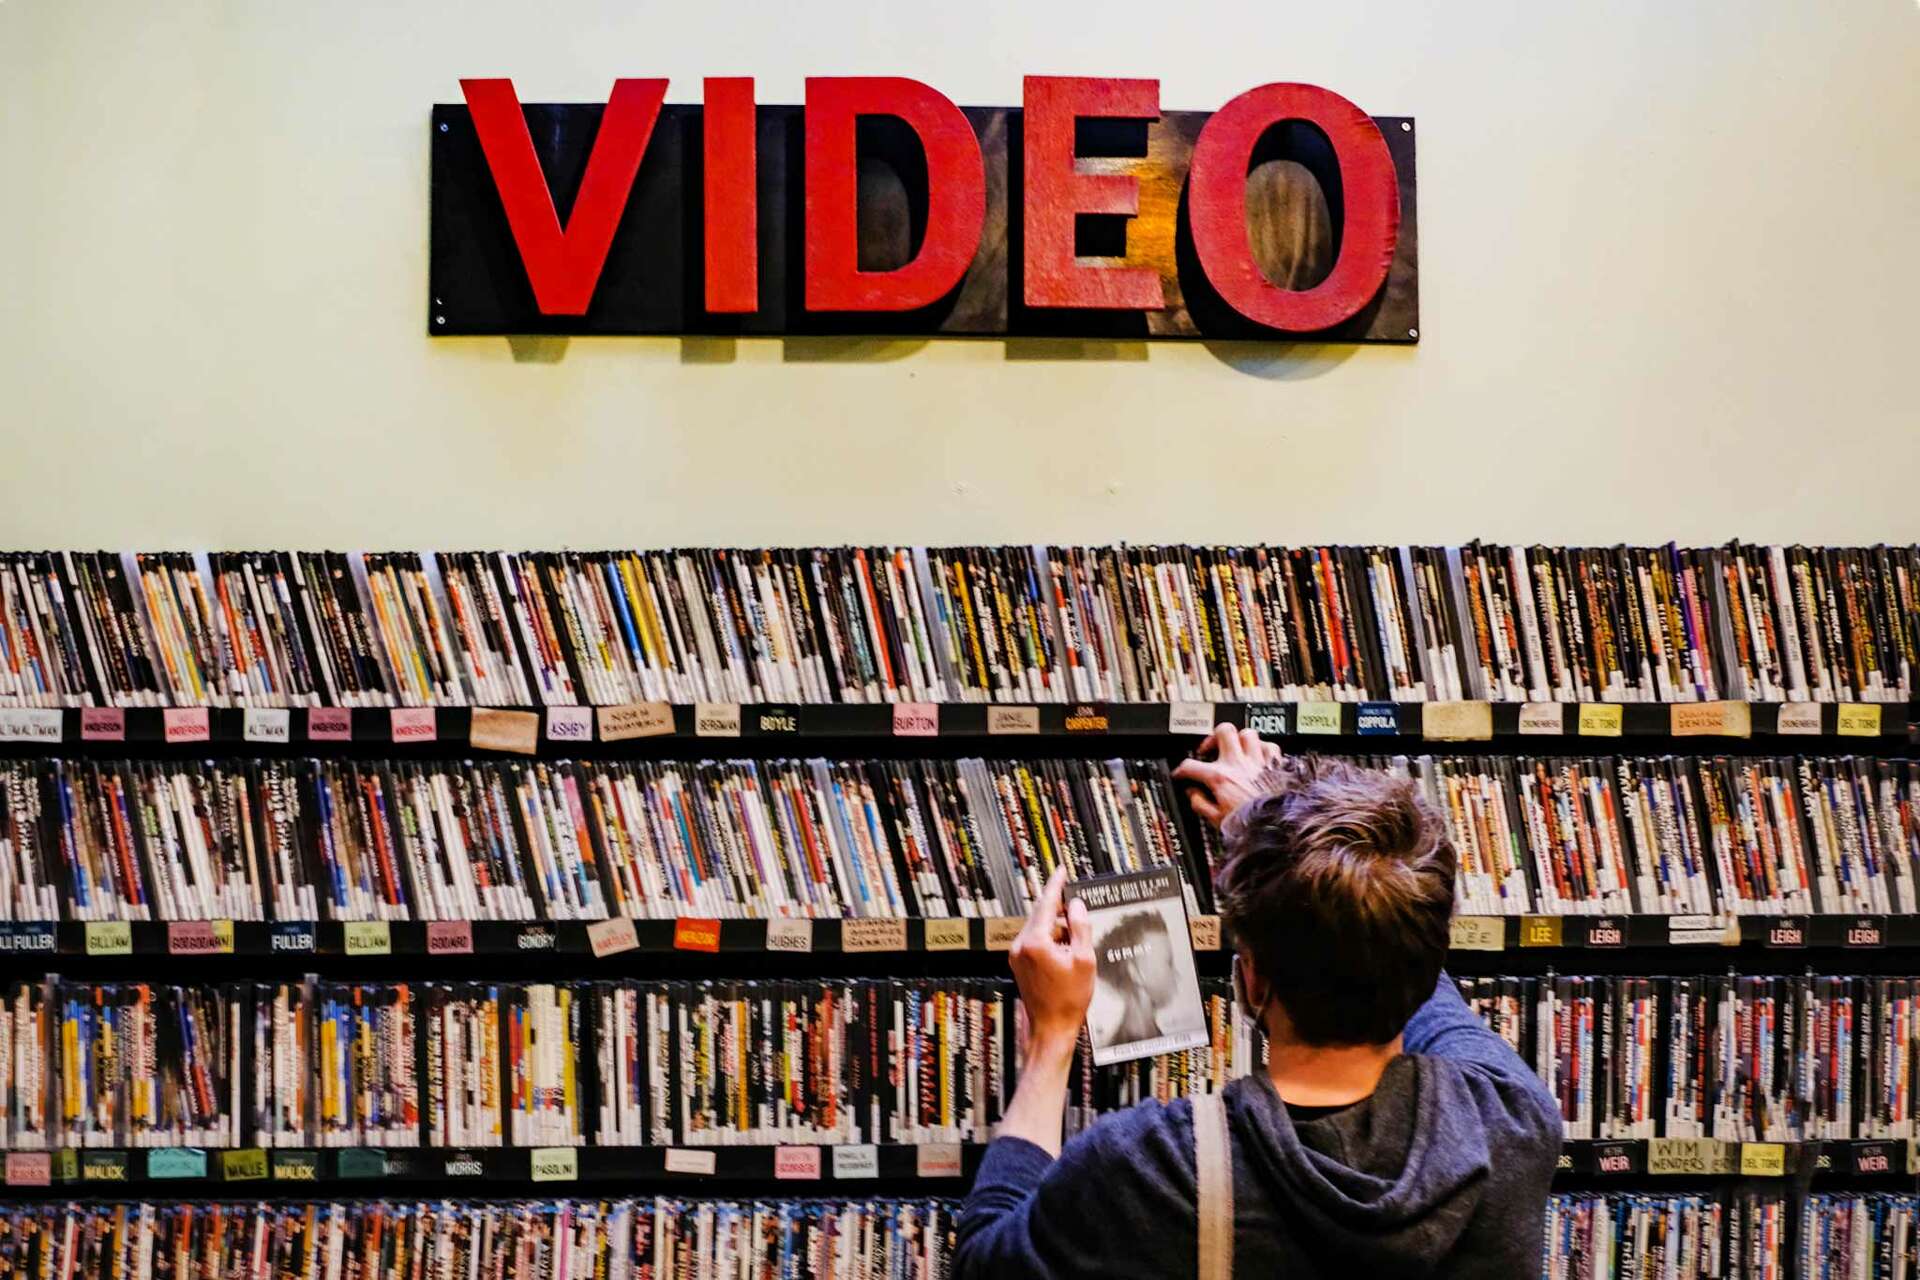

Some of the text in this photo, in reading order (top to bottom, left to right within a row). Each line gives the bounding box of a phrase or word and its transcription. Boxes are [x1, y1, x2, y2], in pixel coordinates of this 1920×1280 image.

[459, 76, 1400, 333] VIDEO
[85, 723, 122, 733] ANDERSON
[312, 723, 348, 733] ANDERSON
[700, 719, 738, 731] BERGMAN
[760, 715, 797, 733] BOYLE
[895, 716, 935, 731] BURTON
[1250, 716, 1287, 734] COEN
[1301, 715, 1338, 728] COPPOLA
[1358, 716, 1397, 729] COPPOLA
[1582, 719, 1619, 729] DEL TORO
[1858, 719, 1877, 729] TORO
[169, 725, 207, 736] ANDERSON
[249, 724, 285, 737] ALTMAN
[396, 725, 433, 737] ANDERSON
[272, 934, 313, 951] FULLER
[517, 934, 556, 949] GONDRY
[769, 934, 807, 949] HUGHES
[928, 935, 966, 945] JACKSON
[1454, 930, 1492, 945] LEE
[1529, 928, 1553, 944] LEE
[1589, 928, 1621, 944] LEIGH
[1770, 929, 1802, 944] LEIGH
[1848, 929, 1880, 944] LEIGH
[1106, 943, 1152, 963] GUMMO
[1655, 1141, 1699, 1157] WIM
[446, 1162, 483, 1176] MORRIS
[1599, 1156, 1631, 1172] WEIR
[1651, 1158, 1705, 1173] WENDERS
[1744, 1159, 1780, 1169] DEL TORO
[1857, 1155, 1889, 1172] WEIR
